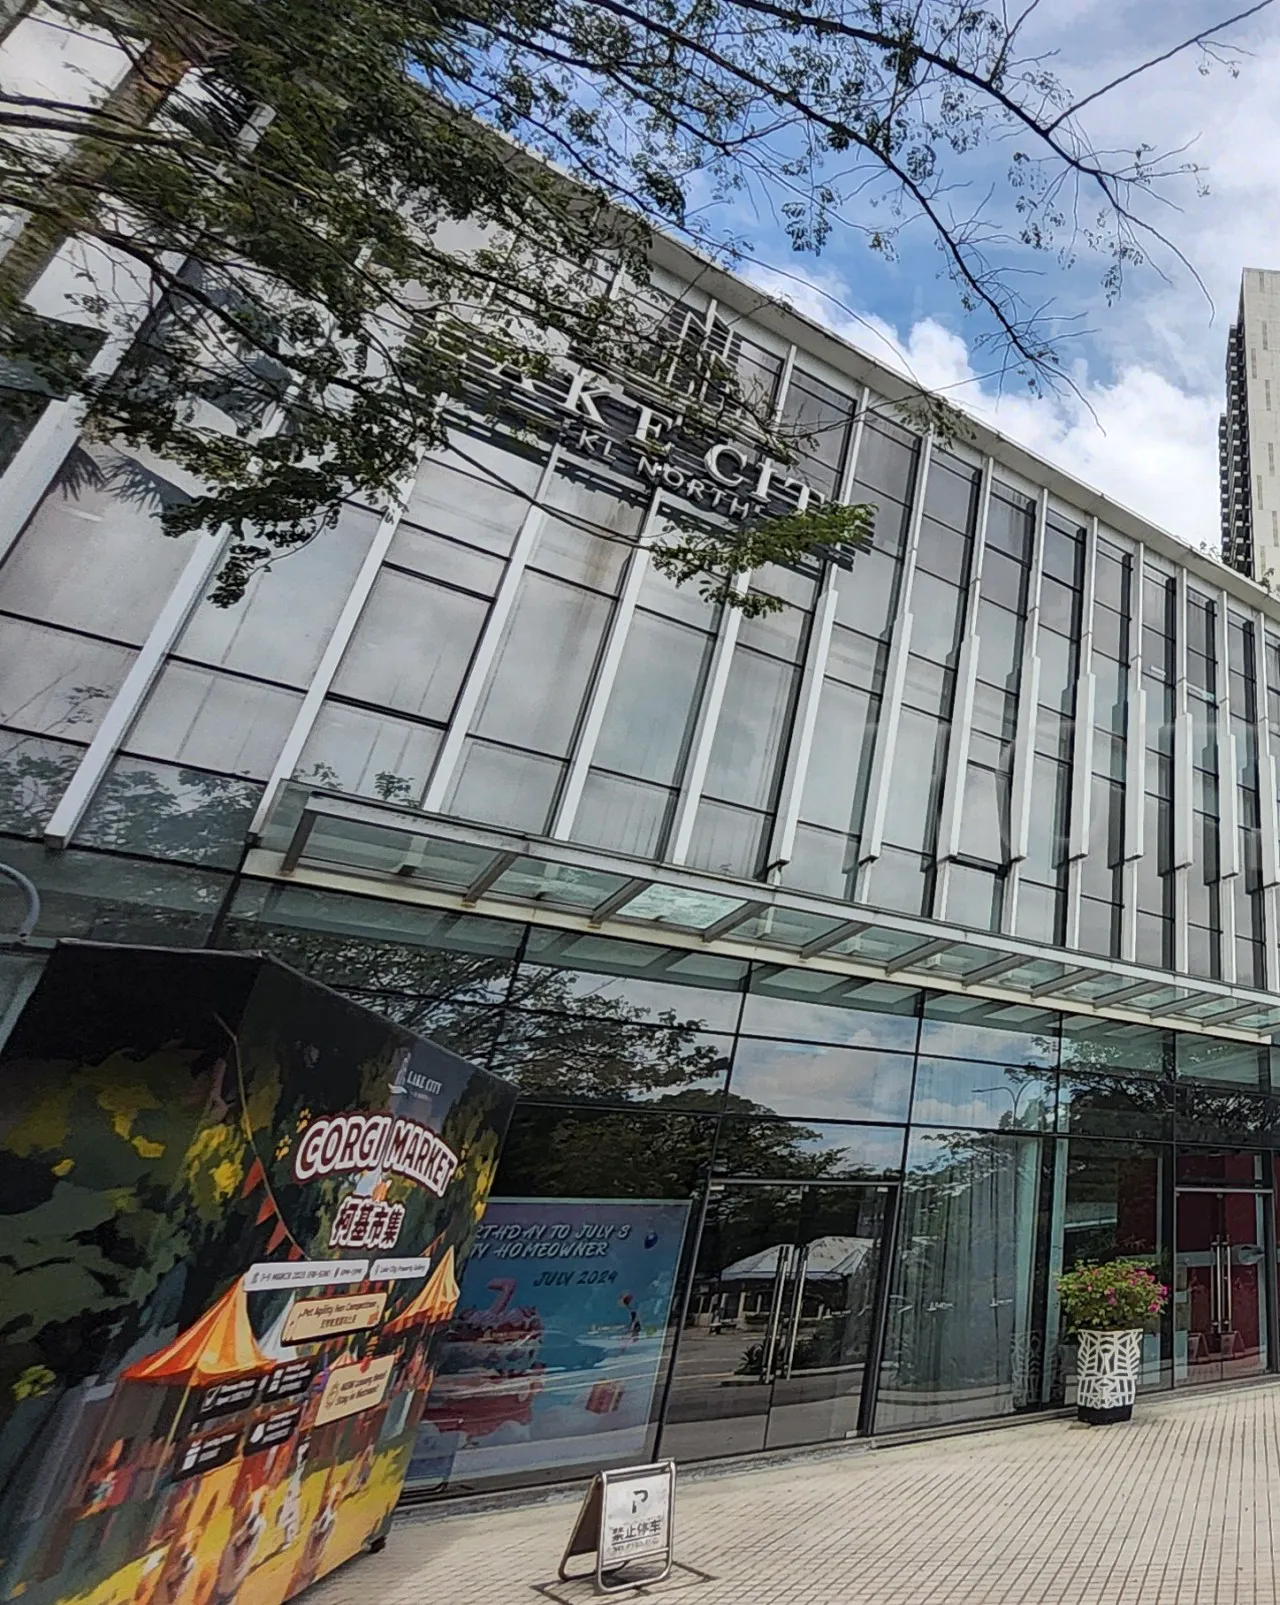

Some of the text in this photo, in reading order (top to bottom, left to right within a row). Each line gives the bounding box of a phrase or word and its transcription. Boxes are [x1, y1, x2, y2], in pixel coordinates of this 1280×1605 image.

[577, 429, 750, 521] KL NORTH
[407, 1071, 442, 1095] LAKE CITY
[296, 1115, 458, 1197] CORGI MARKET
[331, 1198, 404, 1245] 柯基市集
[476, 1224, 547, 1240] RTHDAY
[551, 1224, 571, 1240] TO
[493, 1241, 609, 1258] HOMEOWNER
[533, 1269, 618, 1287] JULY 2024
[612, 1519, 661, 1542] 禁止停车
